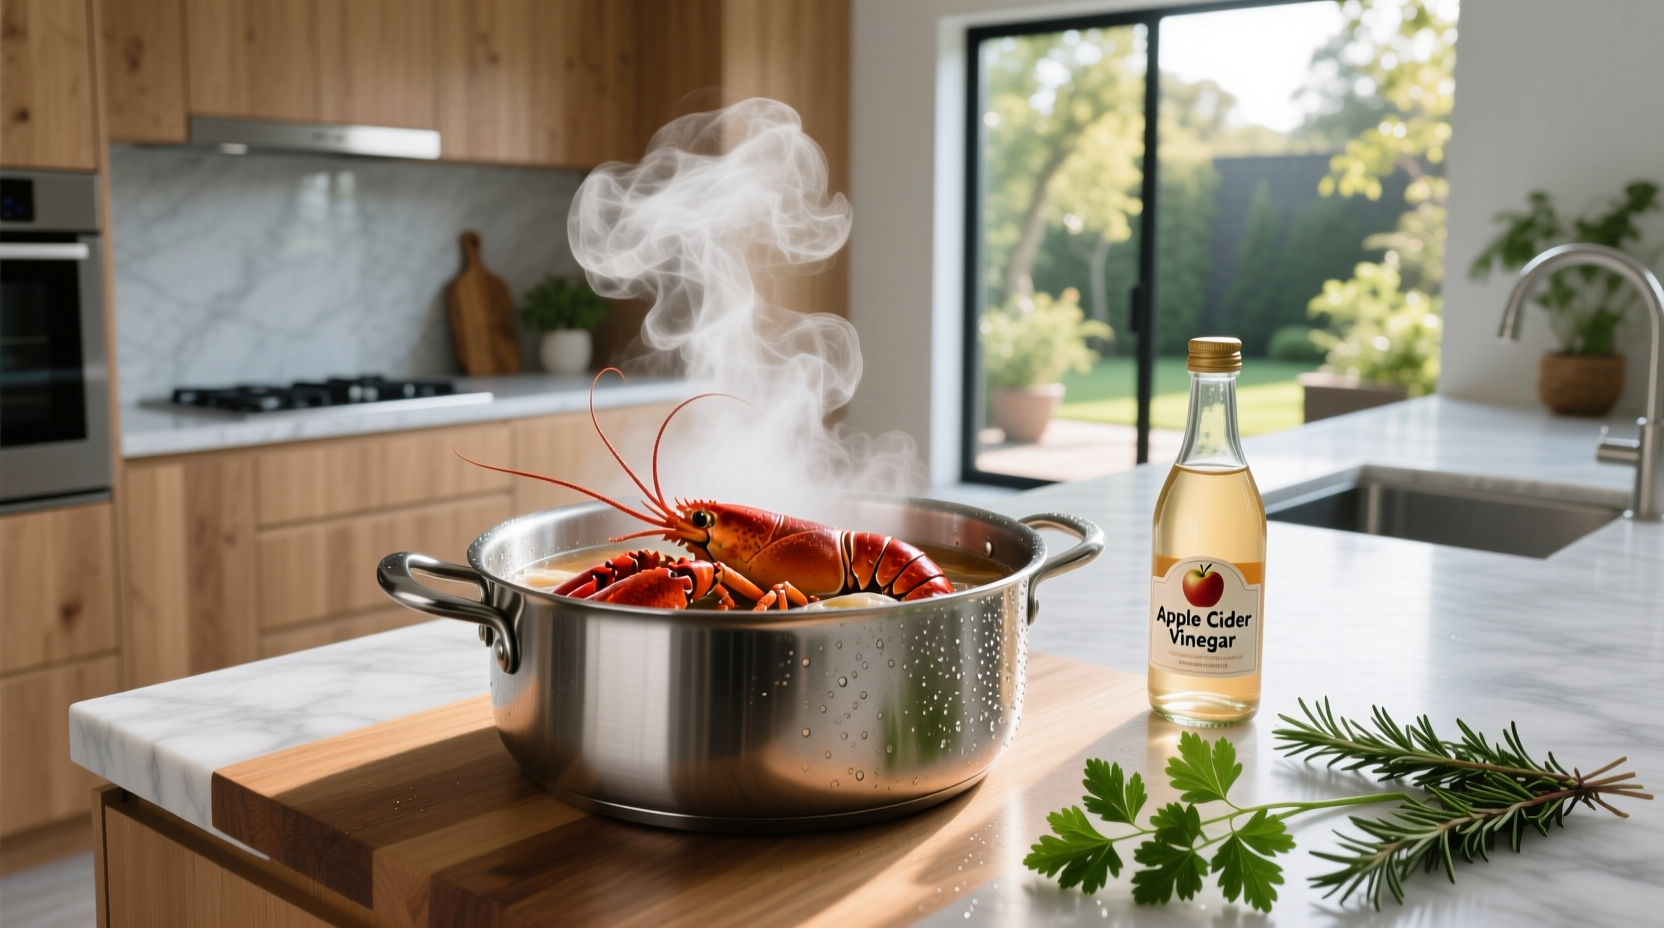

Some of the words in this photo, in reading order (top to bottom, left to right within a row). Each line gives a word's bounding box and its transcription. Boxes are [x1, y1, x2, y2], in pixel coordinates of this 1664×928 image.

[1157, 605, 1201, 629] Apple
[1206, 610, 1252, 628] Cider
[1169, 628, 1236, 653] Vinegar
